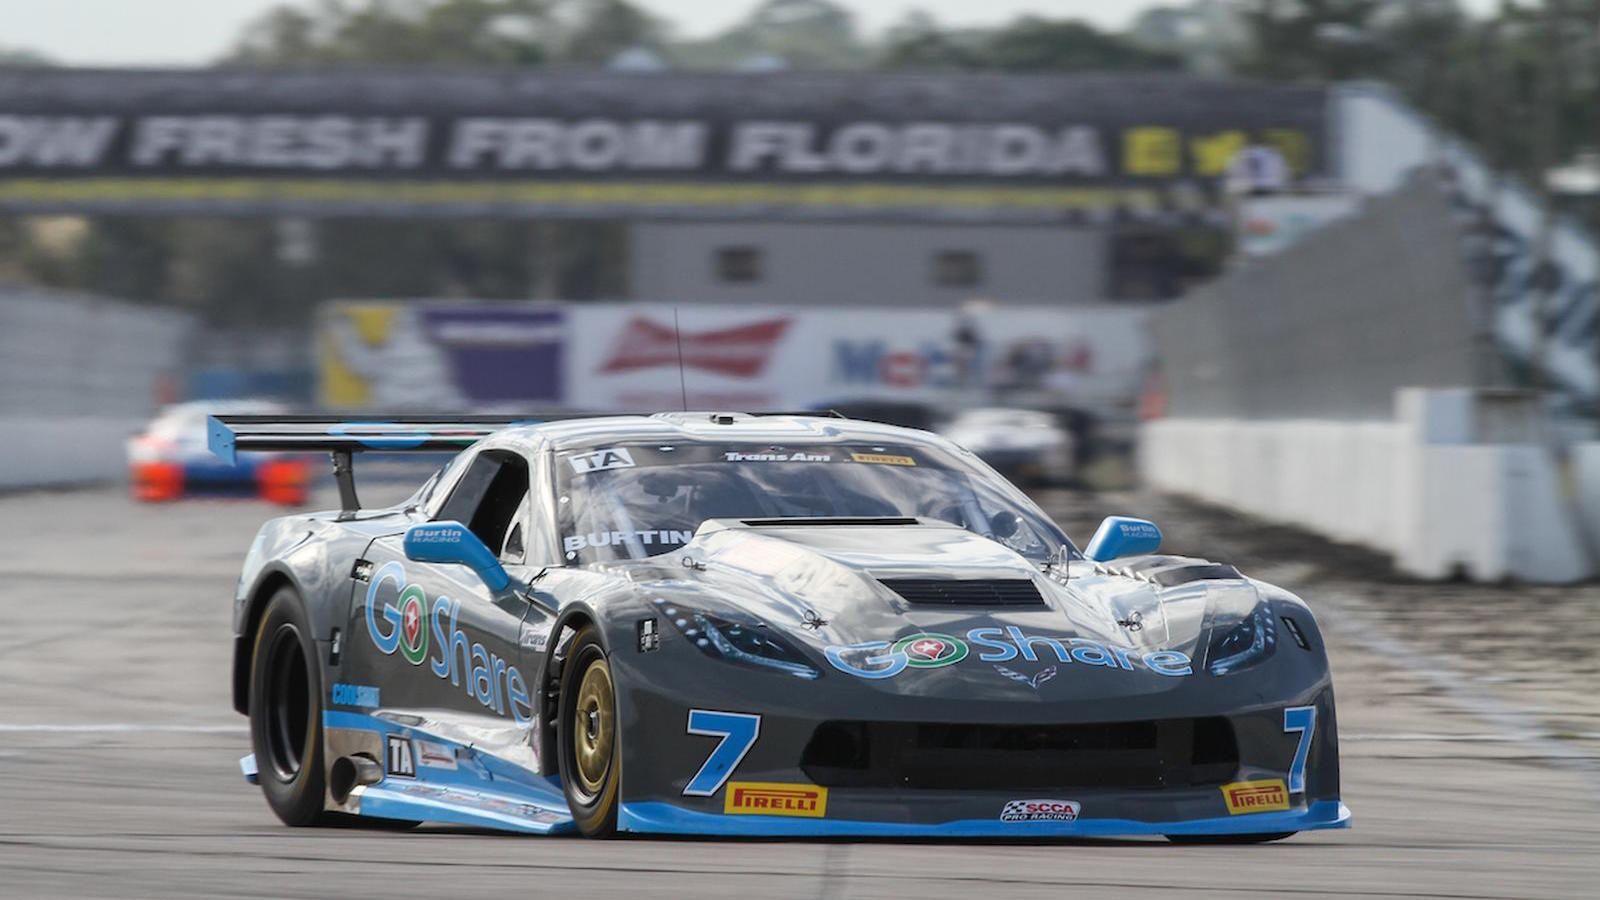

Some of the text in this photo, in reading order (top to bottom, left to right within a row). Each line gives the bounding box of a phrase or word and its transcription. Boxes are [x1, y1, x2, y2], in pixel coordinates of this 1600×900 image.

[131, 115, 427, 168] FRESH
[450, 118, 708, 170] FROM
[727, 122, 1106, 174] FLORIDA
[574, 451, 631, 469] TA
[724, 451, 831, 462] Trans Am
[413, 529, 462, 537] Burtin
[564, 530, 693, 551] BURTIN
[389, 736, 414, 775] TA
[682, 708, 761, 797] 7
[1284, 705, 1316, 793] 7
[733, 788, 818, 811] PIRELLI
[1228, 785, 1284, 808] PIRELLI
[1026, 803, 1074, 814] SCCA
